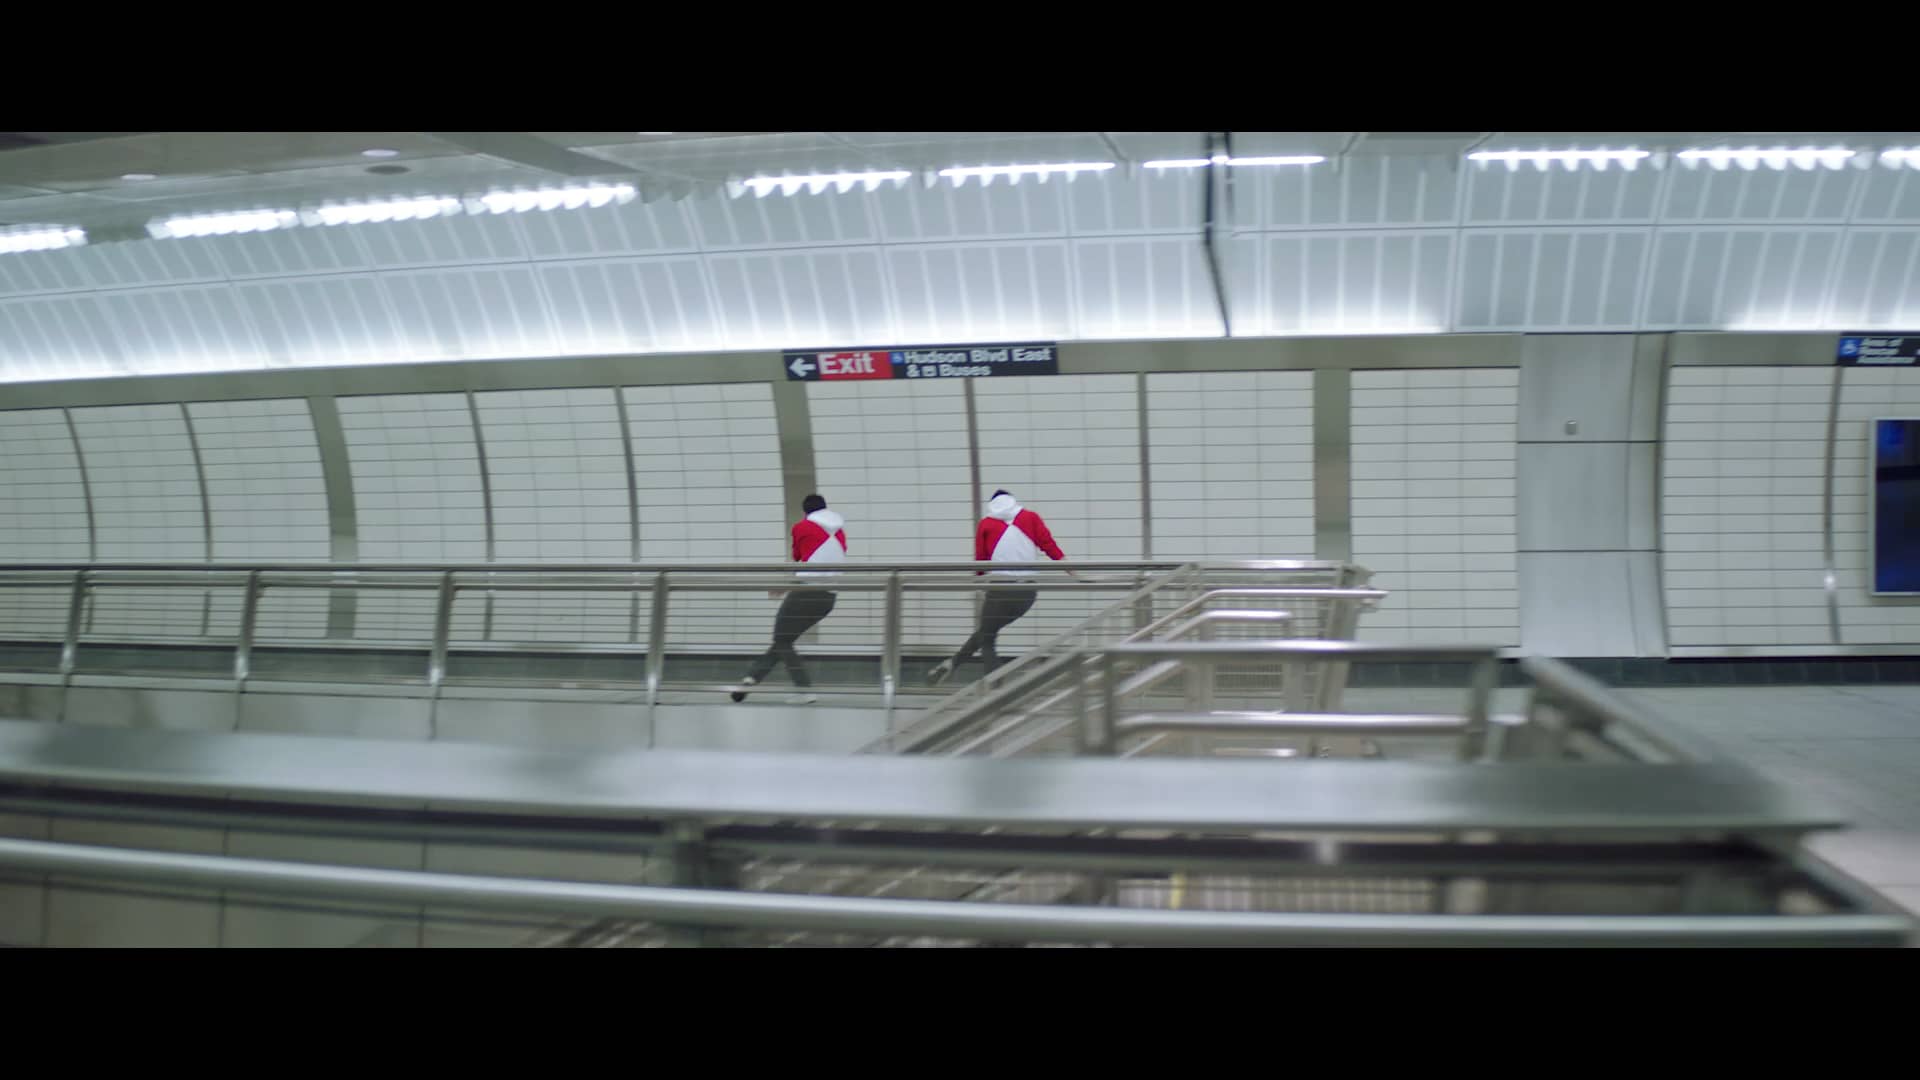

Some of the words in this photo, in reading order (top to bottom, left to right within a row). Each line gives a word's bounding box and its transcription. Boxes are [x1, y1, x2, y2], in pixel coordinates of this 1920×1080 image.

[817, 352, 876, 375] Exit
[903, 350, 967, 364] Hudson
[970, 349, 1009, 362] Blvd
[1012, 347, 1052, 361] East
[939, 363, 991, 377] Buses
